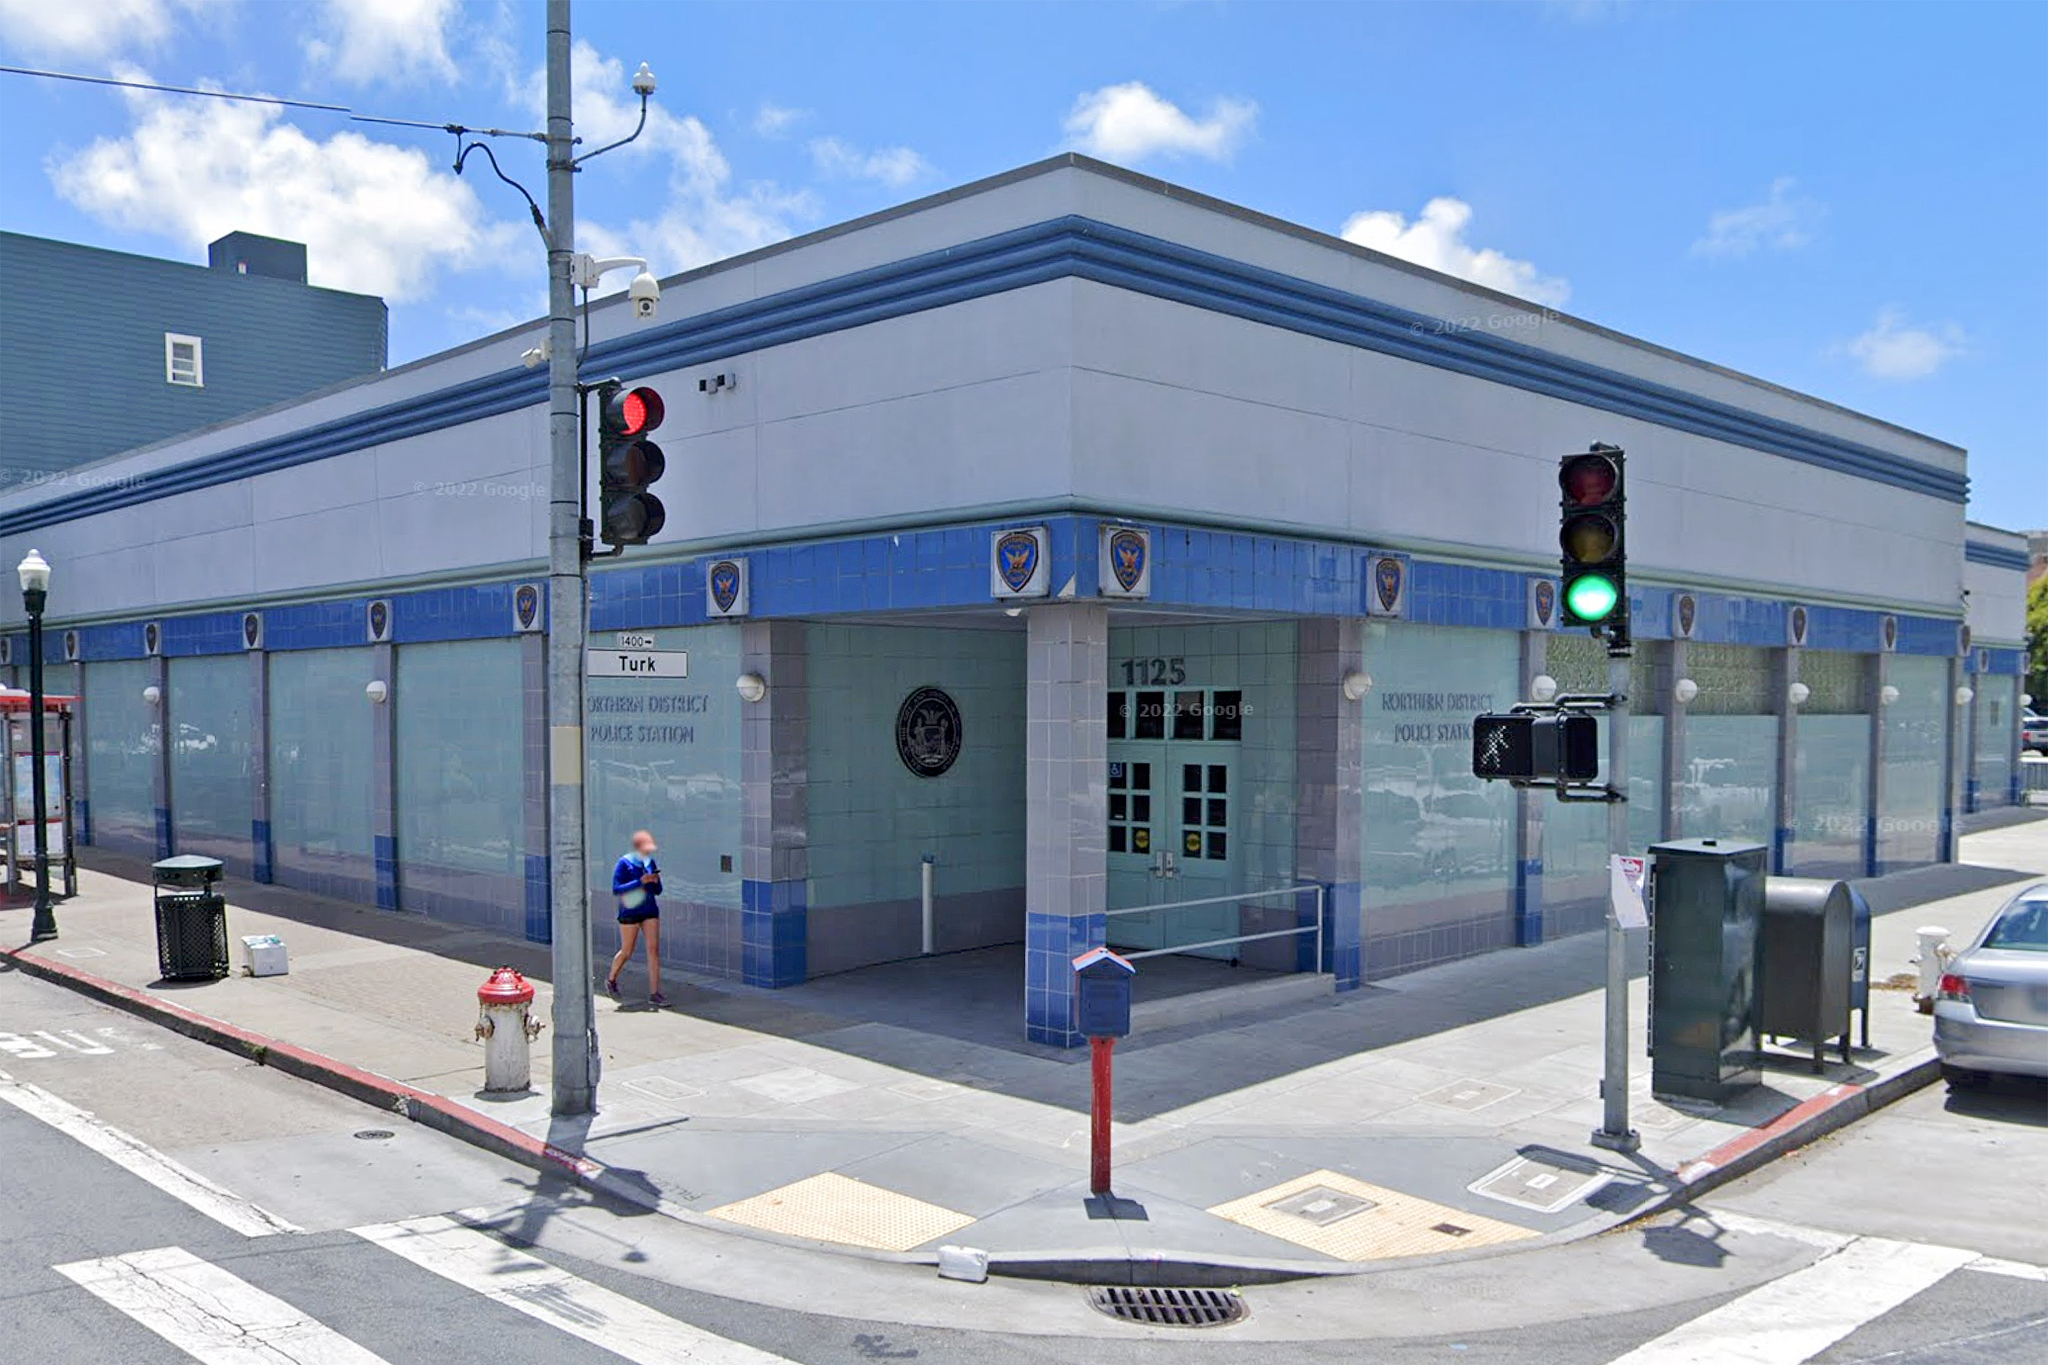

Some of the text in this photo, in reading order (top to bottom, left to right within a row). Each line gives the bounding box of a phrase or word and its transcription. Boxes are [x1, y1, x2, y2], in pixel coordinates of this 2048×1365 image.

[621, 636, 643, 646] 1400
[619, 656, 655, 672] Turk
[1121, 658, 1186, 686] 1125
[587, 694, 708, 713] ORTHERN DISTRICT
[1382, 692, 1493, 711] NORTHERN DISTRICT
[590, 725, 694, 744] POLICE STATION
[1394, 723, 1431, 742] POLICE
